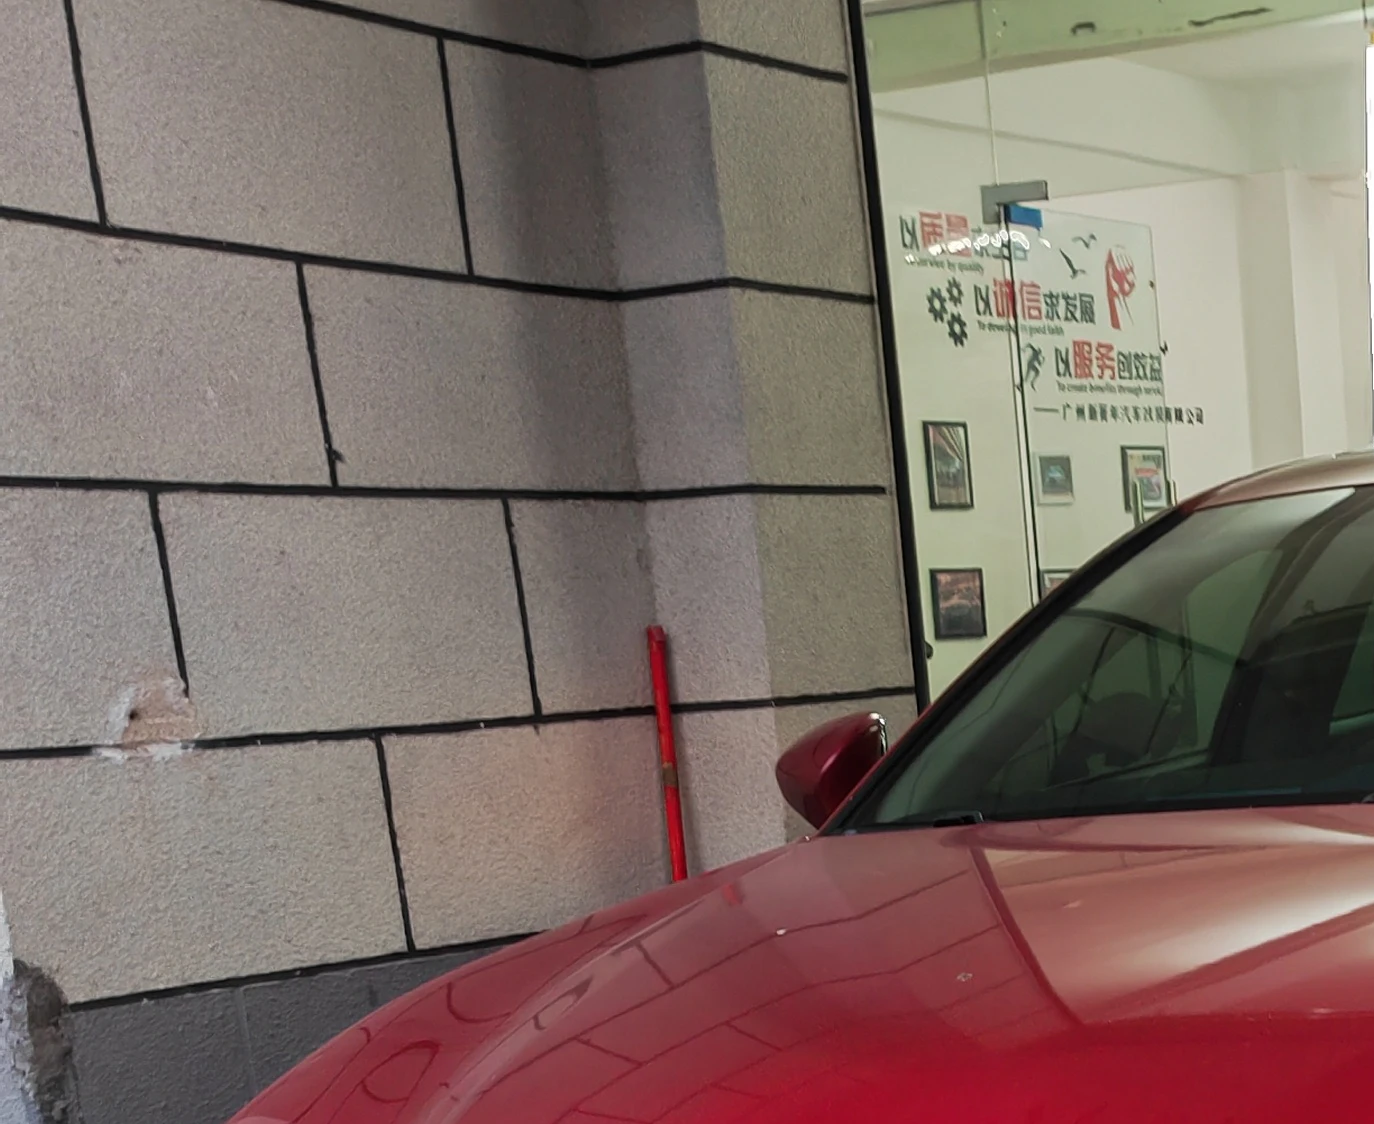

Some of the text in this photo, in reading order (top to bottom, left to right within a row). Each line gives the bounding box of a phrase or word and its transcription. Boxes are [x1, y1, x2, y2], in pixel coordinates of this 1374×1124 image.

[973, 278, 1096, 325] 以诚信求发展
[1055, 340, 1162, 381] 以服务创效益
